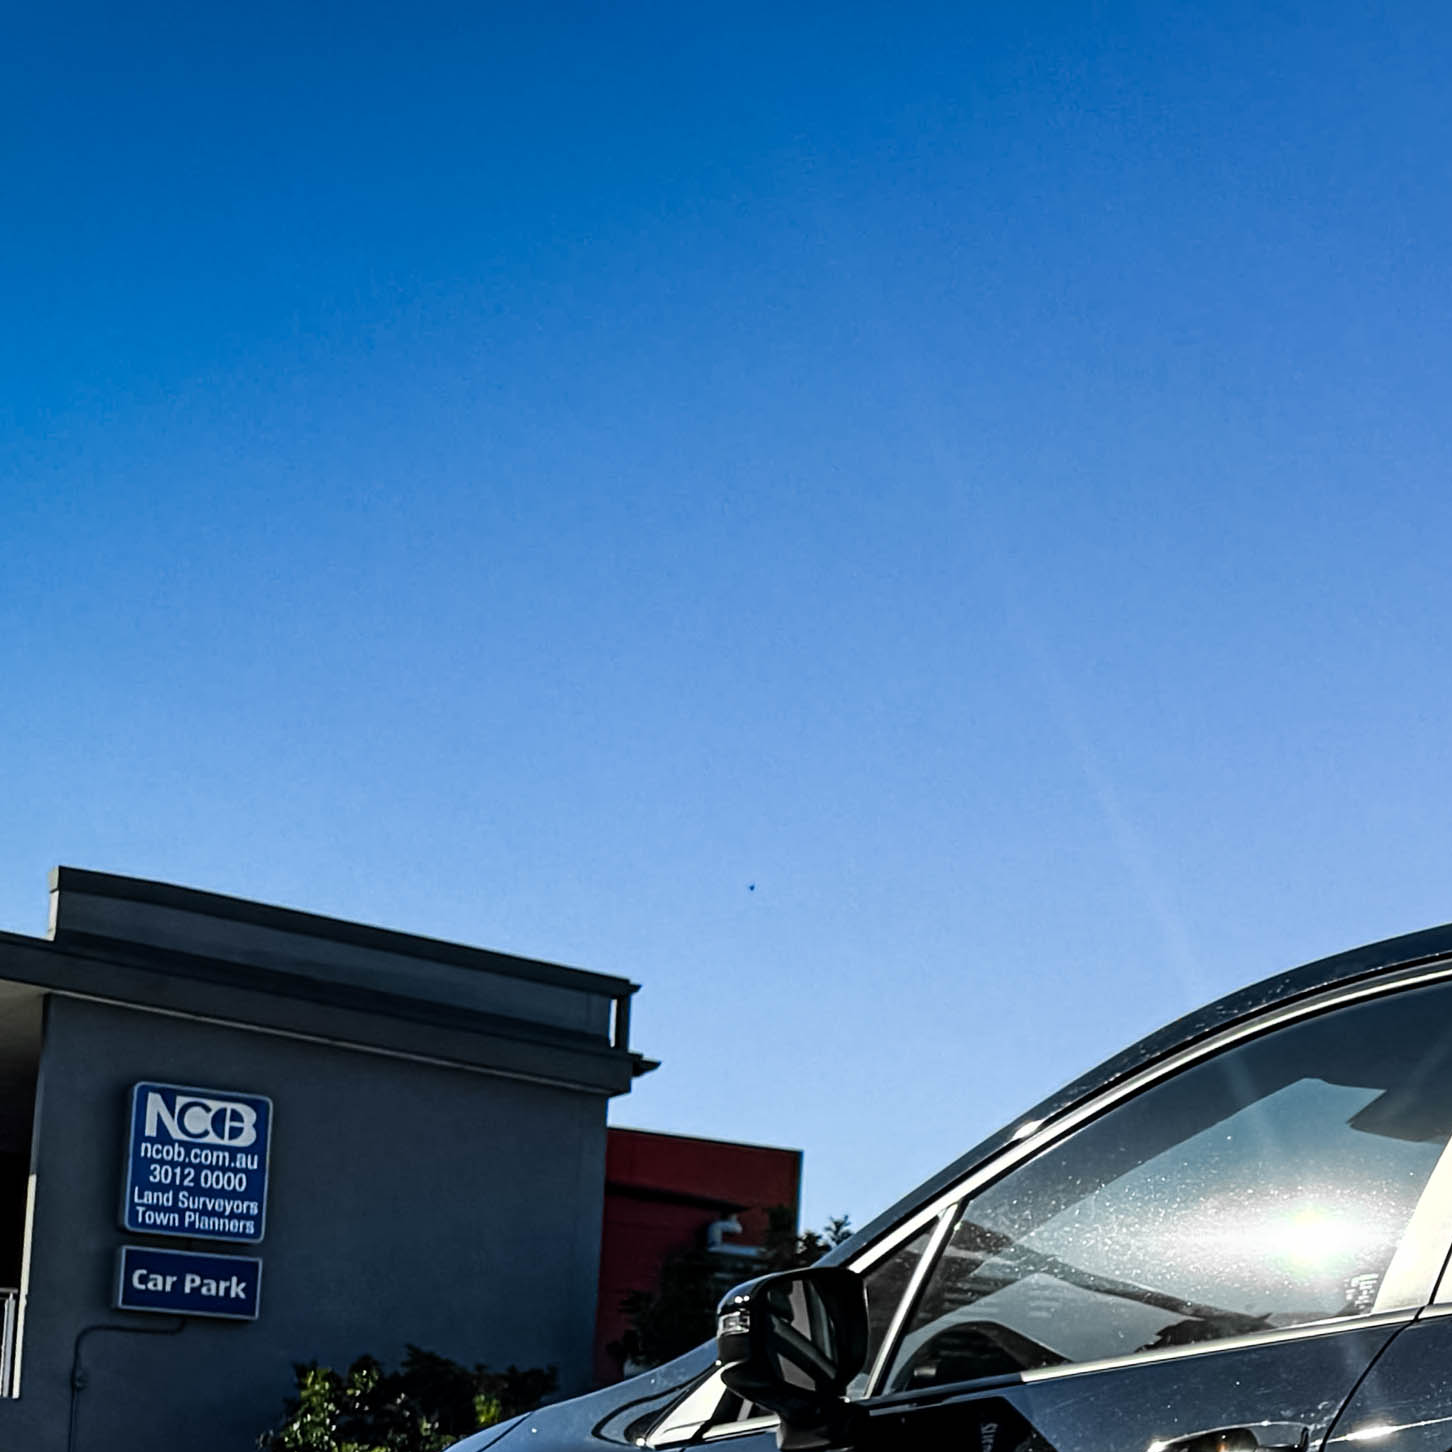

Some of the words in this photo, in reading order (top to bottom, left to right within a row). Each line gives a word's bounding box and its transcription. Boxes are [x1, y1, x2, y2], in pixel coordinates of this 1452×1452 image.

[145, 1091, 257, 1147] NCOB
[140, 1141, 258, 1170] ncob.com.au
[149, 1163, 195, 1187] 3012
[200, 1169, 247, 1192] 0000
[134, 1185, 173, 1207] Land
[178, 1190, 259, 1216] Surveyors
[136, 1206, 179, 1227] Town
[184, 1210, 255, 1235] Planners
[132, 1269, 177, 1293] Car
[184, 1273, 247, 1299] Park
